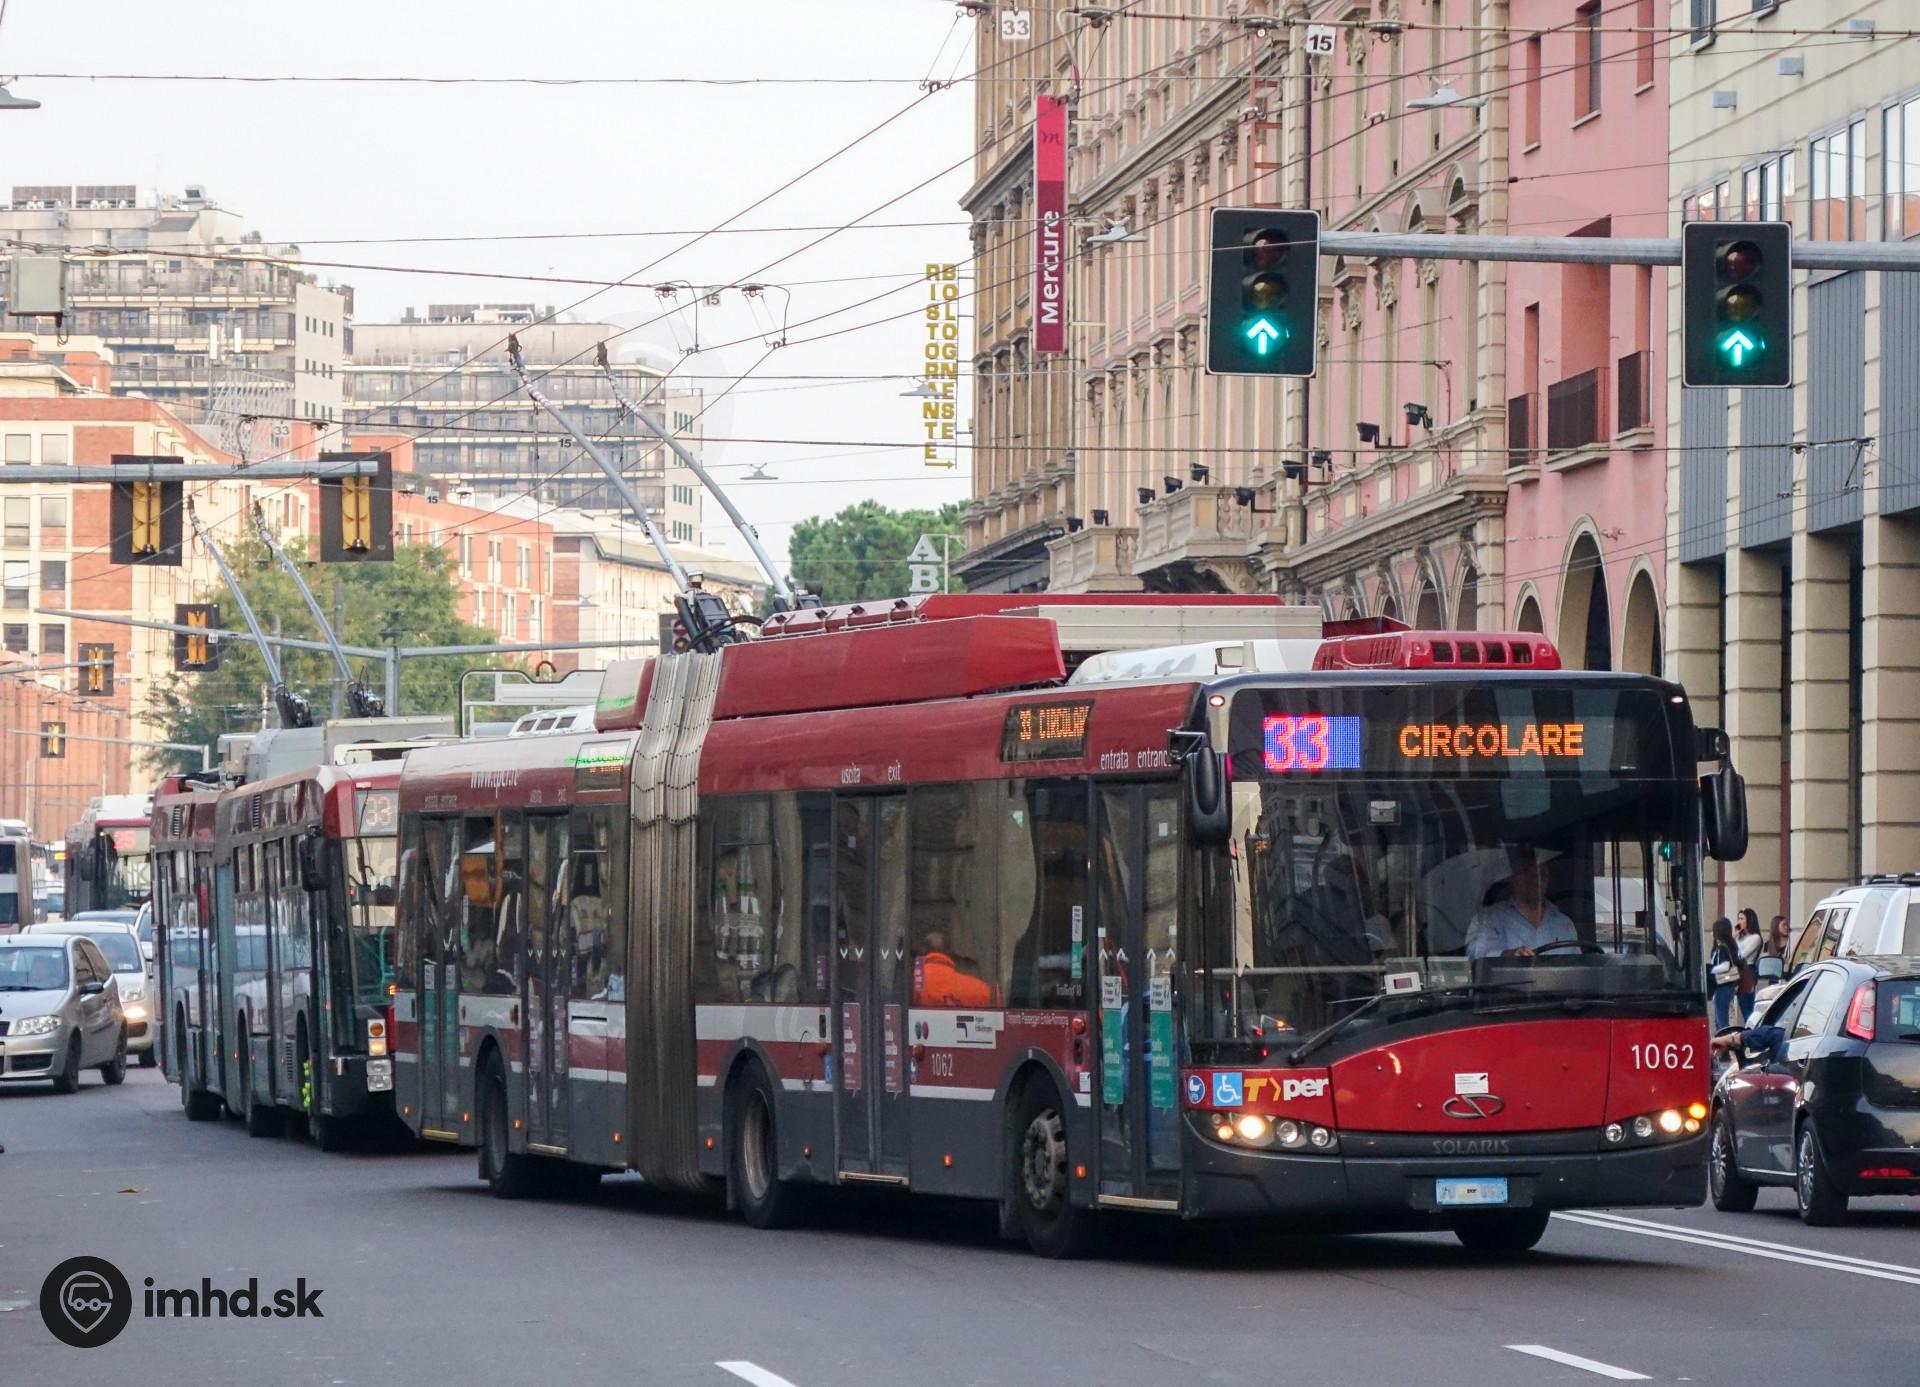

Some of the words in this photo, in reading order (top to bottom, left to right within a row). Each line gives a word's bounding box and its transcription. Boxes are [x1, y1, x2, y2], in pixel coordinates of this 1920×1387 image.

[1003, 19, 1029, 36] 33
[1309, 34, 1333, 51] 15
[1040, 210, 1060, 324] Mercure
[705, 293, 720, 305] 15
[940, 263, 958, 440] BOLOGNESE
[274, 425, 289, 436] 33
[559, 438, 572, 448] 15
[427, 495, 439, 504] 15
[1264, 715, 1329, 770] 33
[1400, 724, 1584, 757] CIRCOLARE
[1100, 748, 1129, 770] entrata
[1137, 746, 1172, 768] entranc
[841, 762, 861, 784] uscita
[888, 760, 901, 781] exit
[366, 796, 392, 826] 33
[931, 1053, 953, 1077] 1062
[1631, 1043, 1695, 1070] 1062
[1432, 1139, 1510, 1155] SOLARIS
